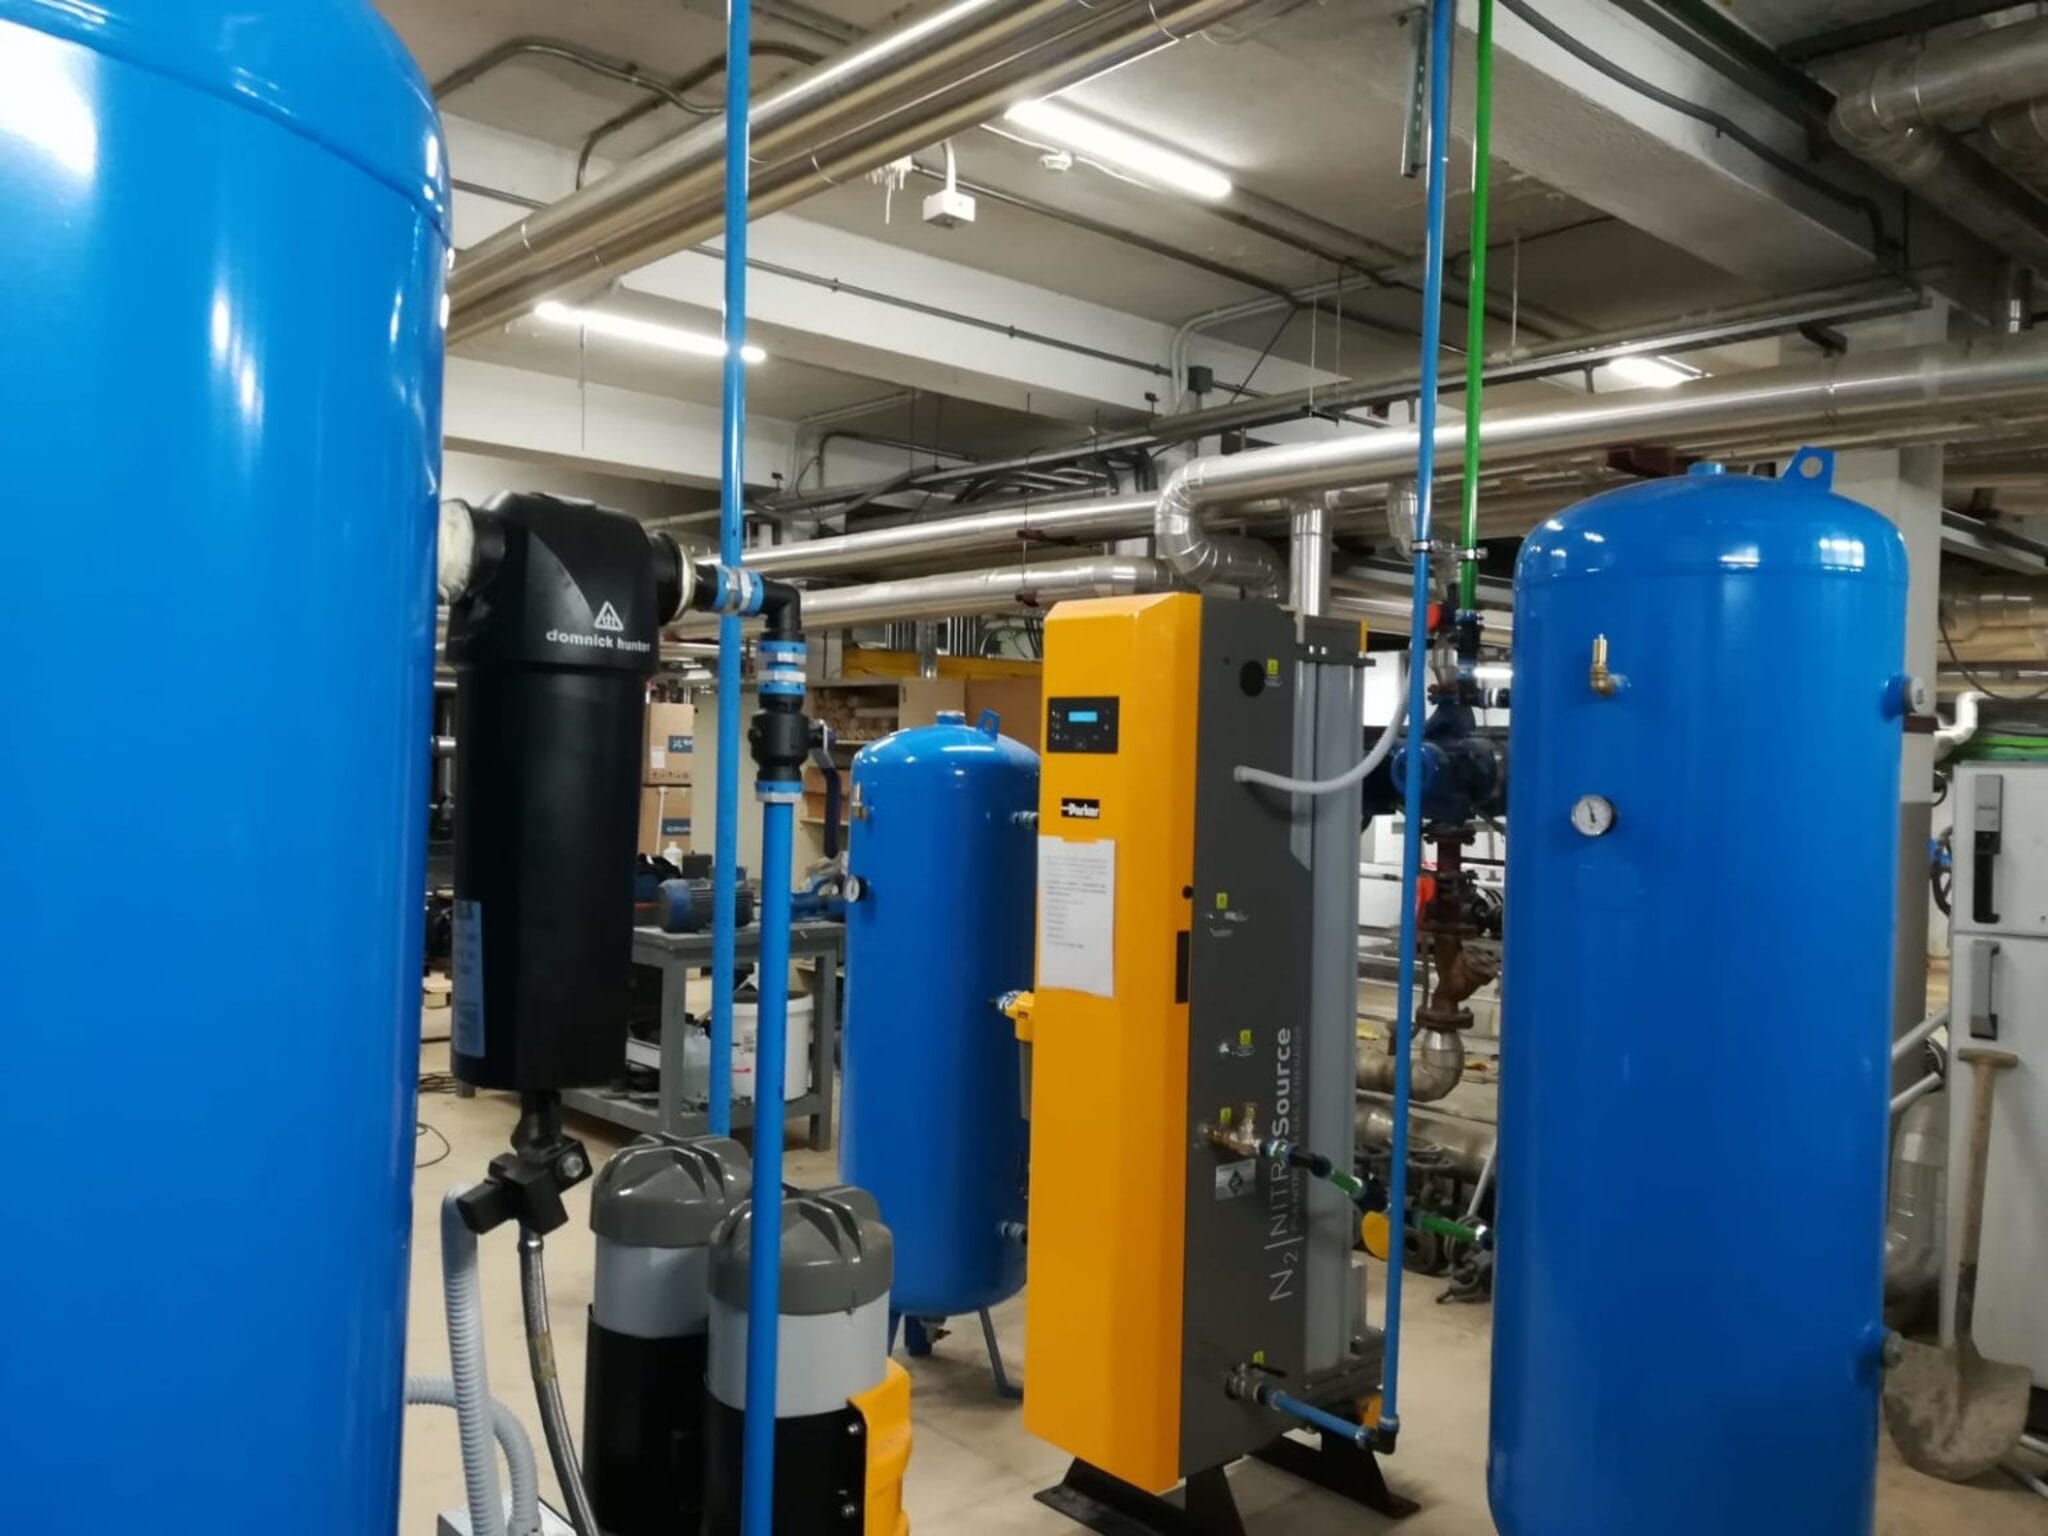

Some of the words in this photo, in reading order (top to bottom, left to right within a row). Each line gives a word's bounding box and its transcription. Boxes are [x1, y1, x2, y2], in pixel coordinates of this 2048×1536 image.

[546, 629, 614, 649] domnick
[617, 637, 651, 653] hunter
[1270, 1027, 1291, 1237] NITRSource
